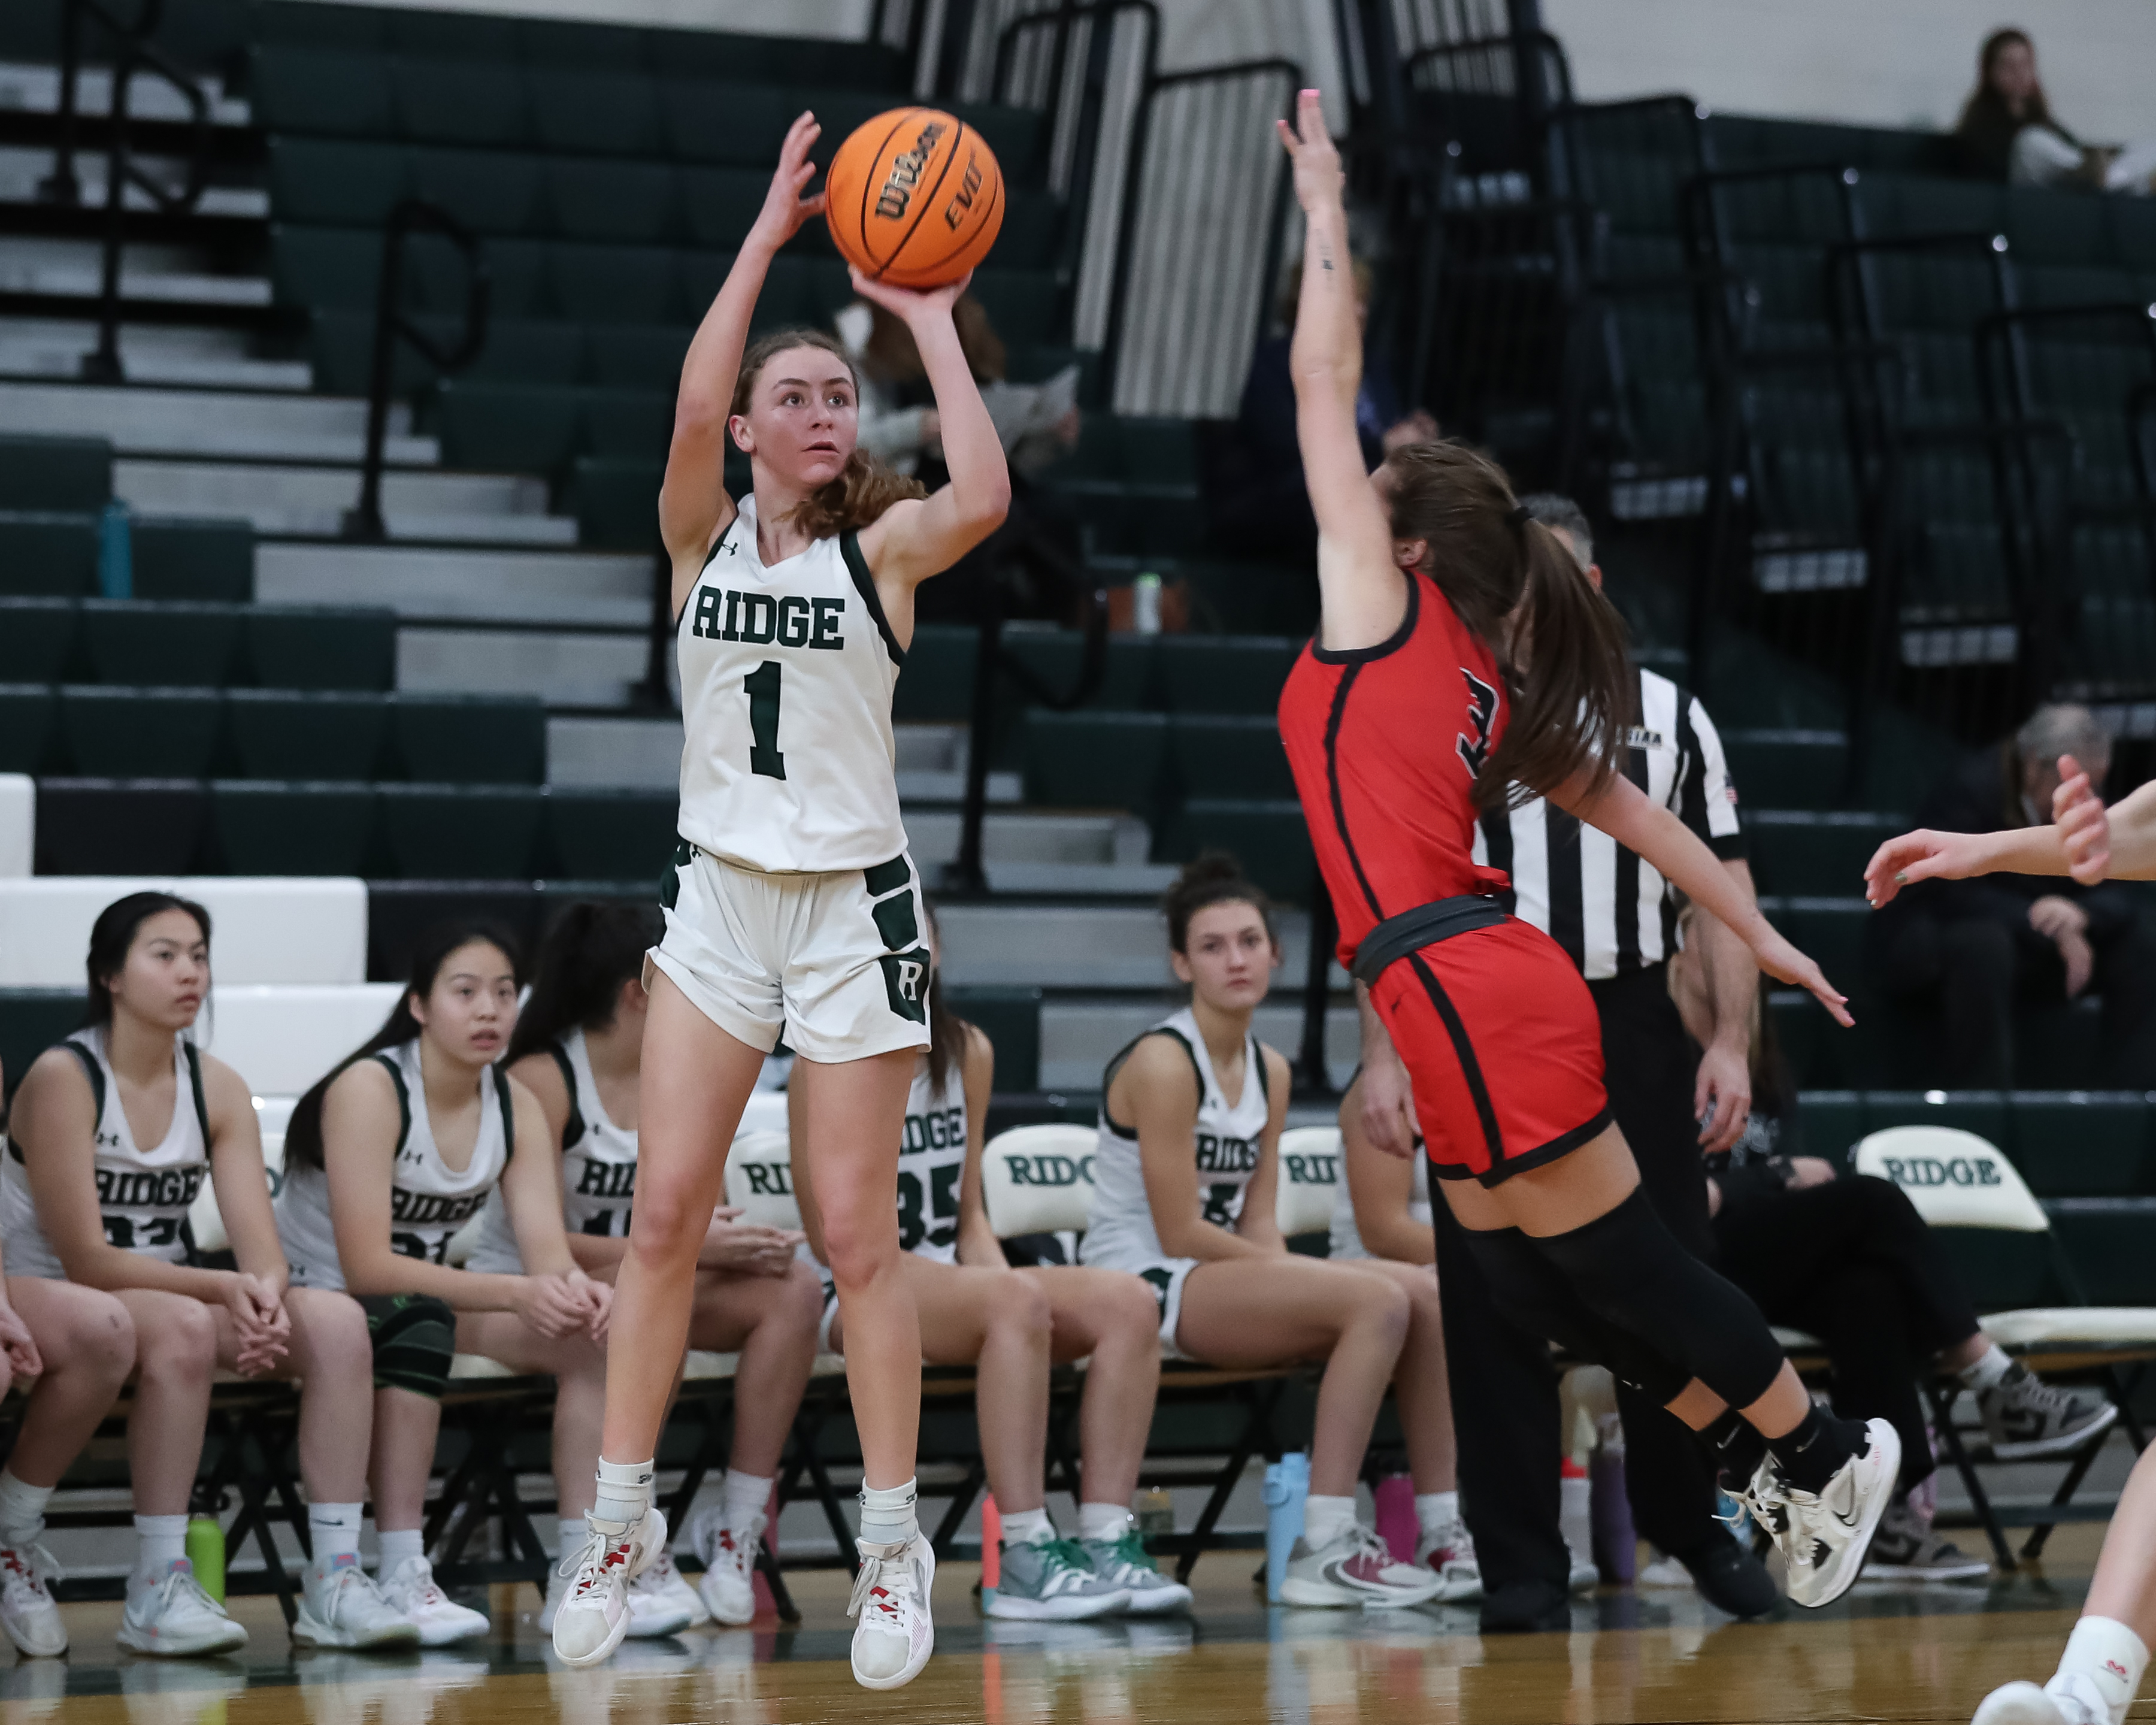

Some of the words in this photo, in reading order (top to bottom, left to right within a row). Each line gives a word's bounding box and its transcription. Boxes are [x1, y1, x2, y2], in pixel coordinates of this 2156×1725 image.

[874, 122, 947, 219] Wilson
[693, 585, 845, 650] RIDGE
[743, 660, 787, 781] 1
[898, 960, 923, 1001] R
[900, 1107, 965, 1155] DGE
[1883, 1158, 2000, 1186] RIDGE
